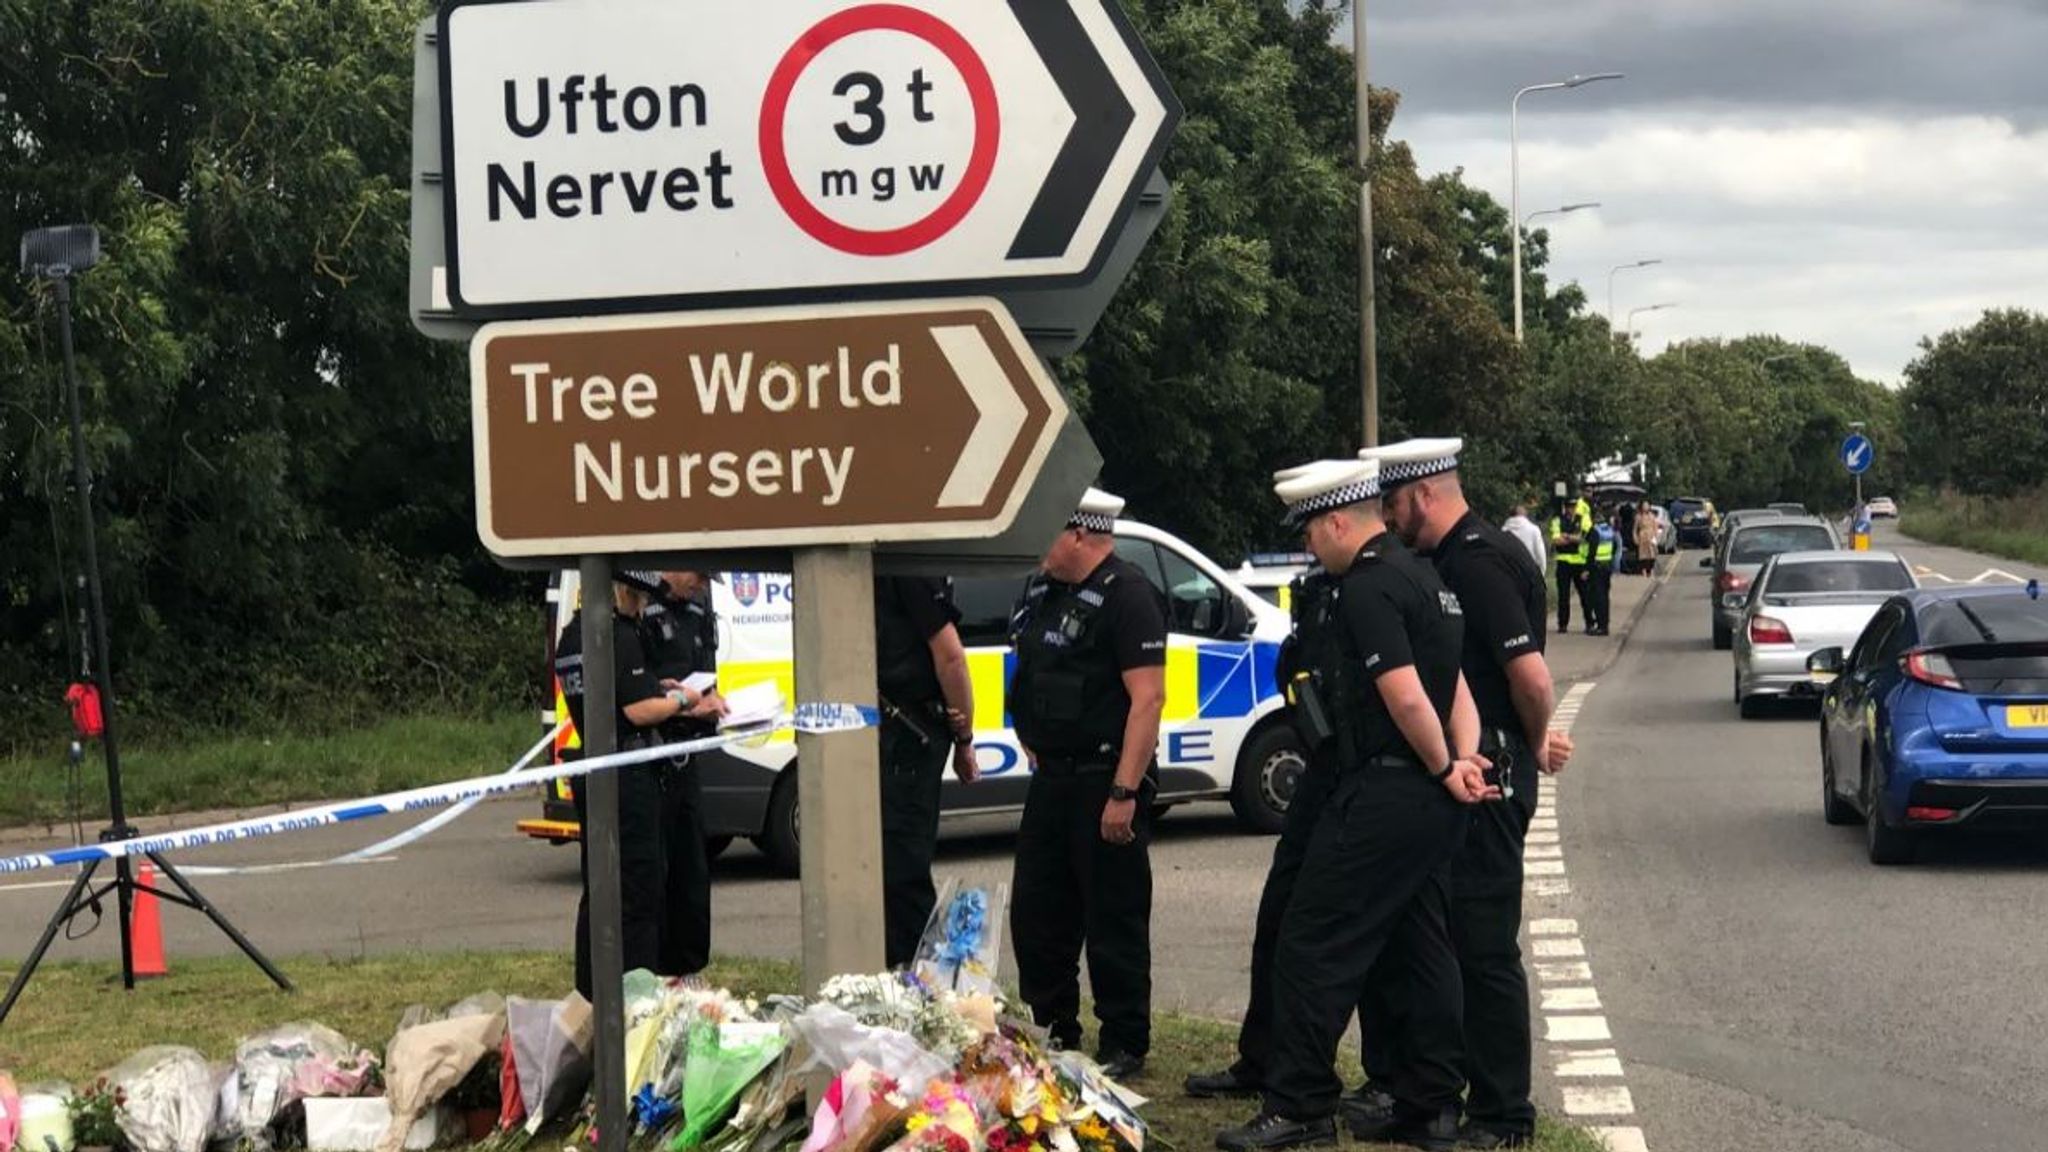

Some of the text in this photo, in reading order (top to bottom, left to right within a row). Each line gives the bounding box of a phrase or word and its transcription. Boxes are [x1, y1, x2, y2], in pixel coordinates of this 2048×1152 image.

[504, 74, 707, 139] Ufton
[832, 68, 934, 146] 3 t
[487, 149, 734, 222] Nervet
[510, 343, 902, 423] Tree World
[574, 441, 855, 506] Nursery
